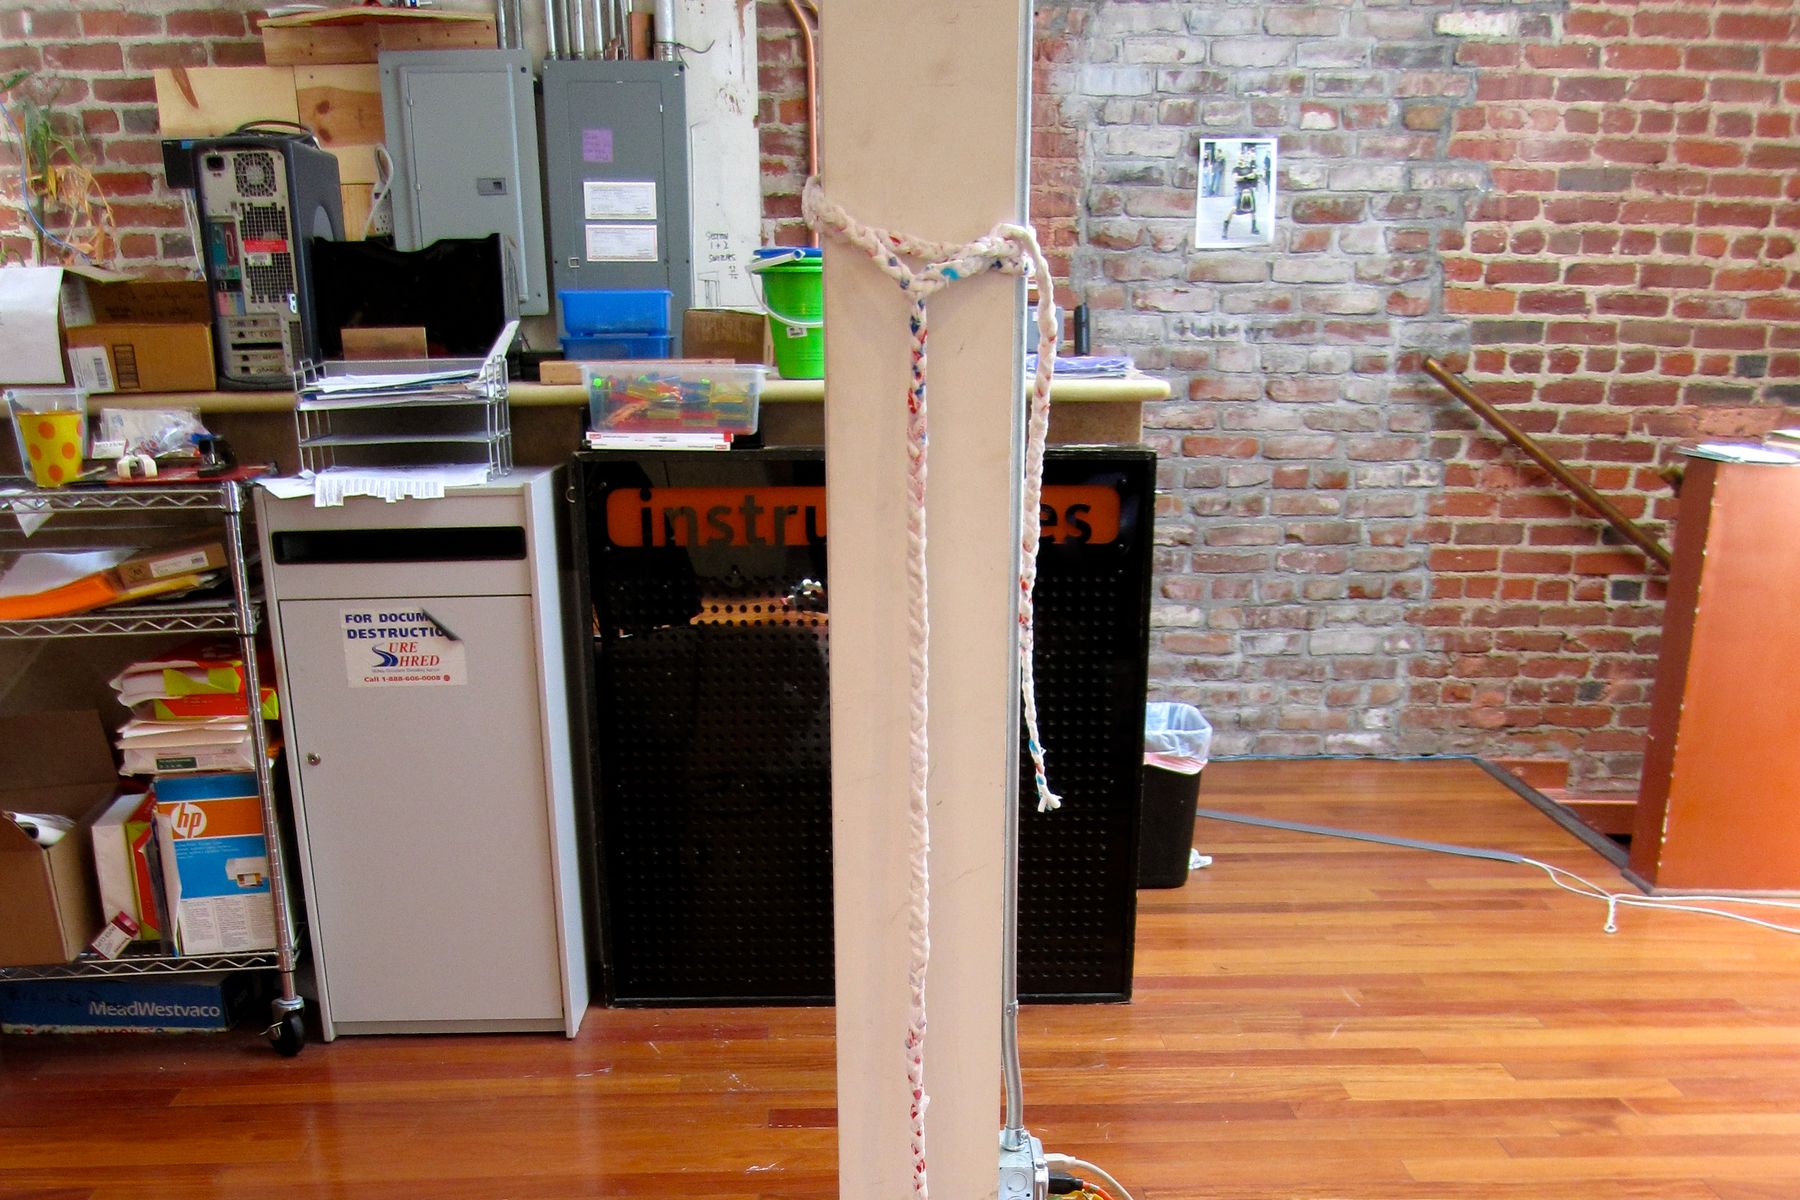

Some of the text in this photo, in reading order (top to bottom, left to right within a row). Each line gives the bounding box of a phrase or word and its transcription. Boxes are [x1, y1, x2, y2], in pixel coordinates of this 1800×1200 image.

[345, 614, 372, 623] FOR
[176, 802, 203, 838] hp
[89, 1001, 221, 1017] MeadWestvaco
